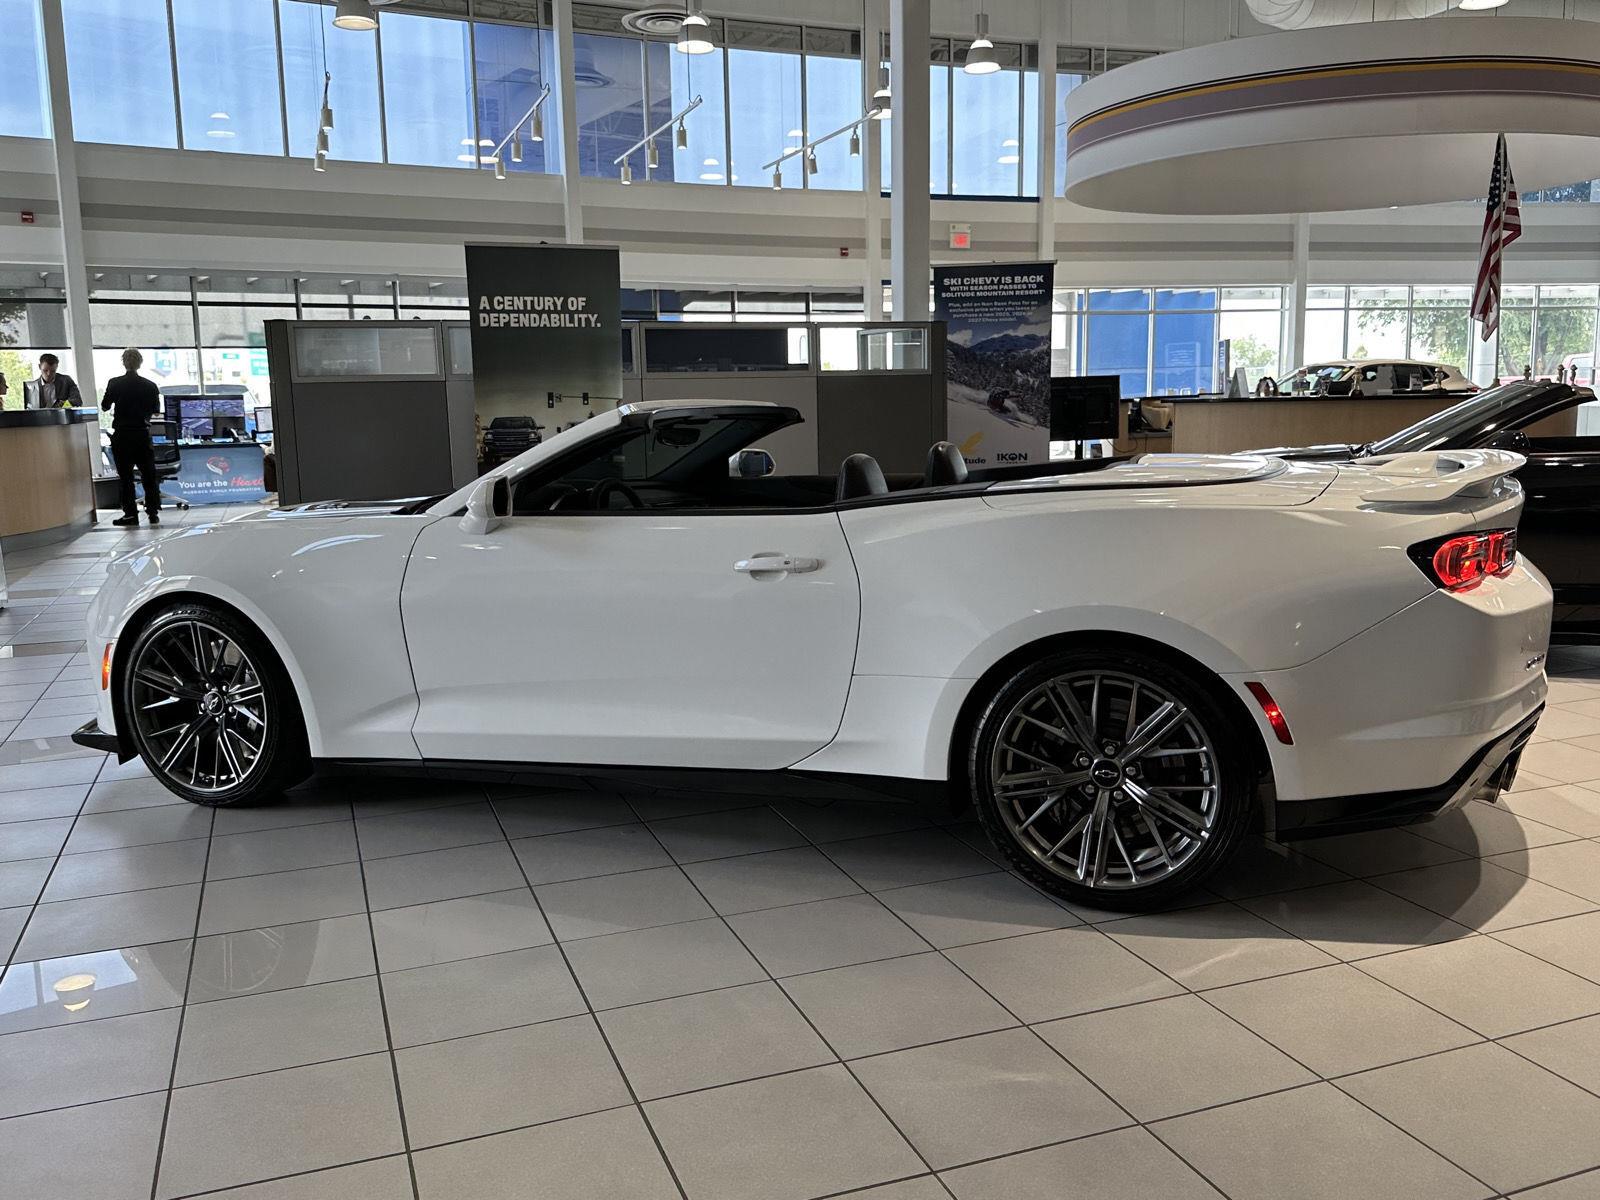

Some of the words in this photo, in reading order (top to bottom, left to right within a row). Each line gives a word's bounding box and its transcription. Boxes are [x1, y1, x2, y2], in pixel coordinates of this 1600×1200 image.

[943, 278, 961, 286] SKI
[963, 277, 999, 285] CHEVY
[1001, 276, 1012, 284] IS
[1014, 275, 1044, 283] BACK
[479, 296, 490, 310] A
[493, 296, 563, 311] CENTURY
[567, 296, 587, 311] OF
[479, 313, 602, 328] DEPENDABILITY.
[997, 453, 1028, 461] IKON
[178, 481, 196, 489] You
[213, 479, 228, 487] the
